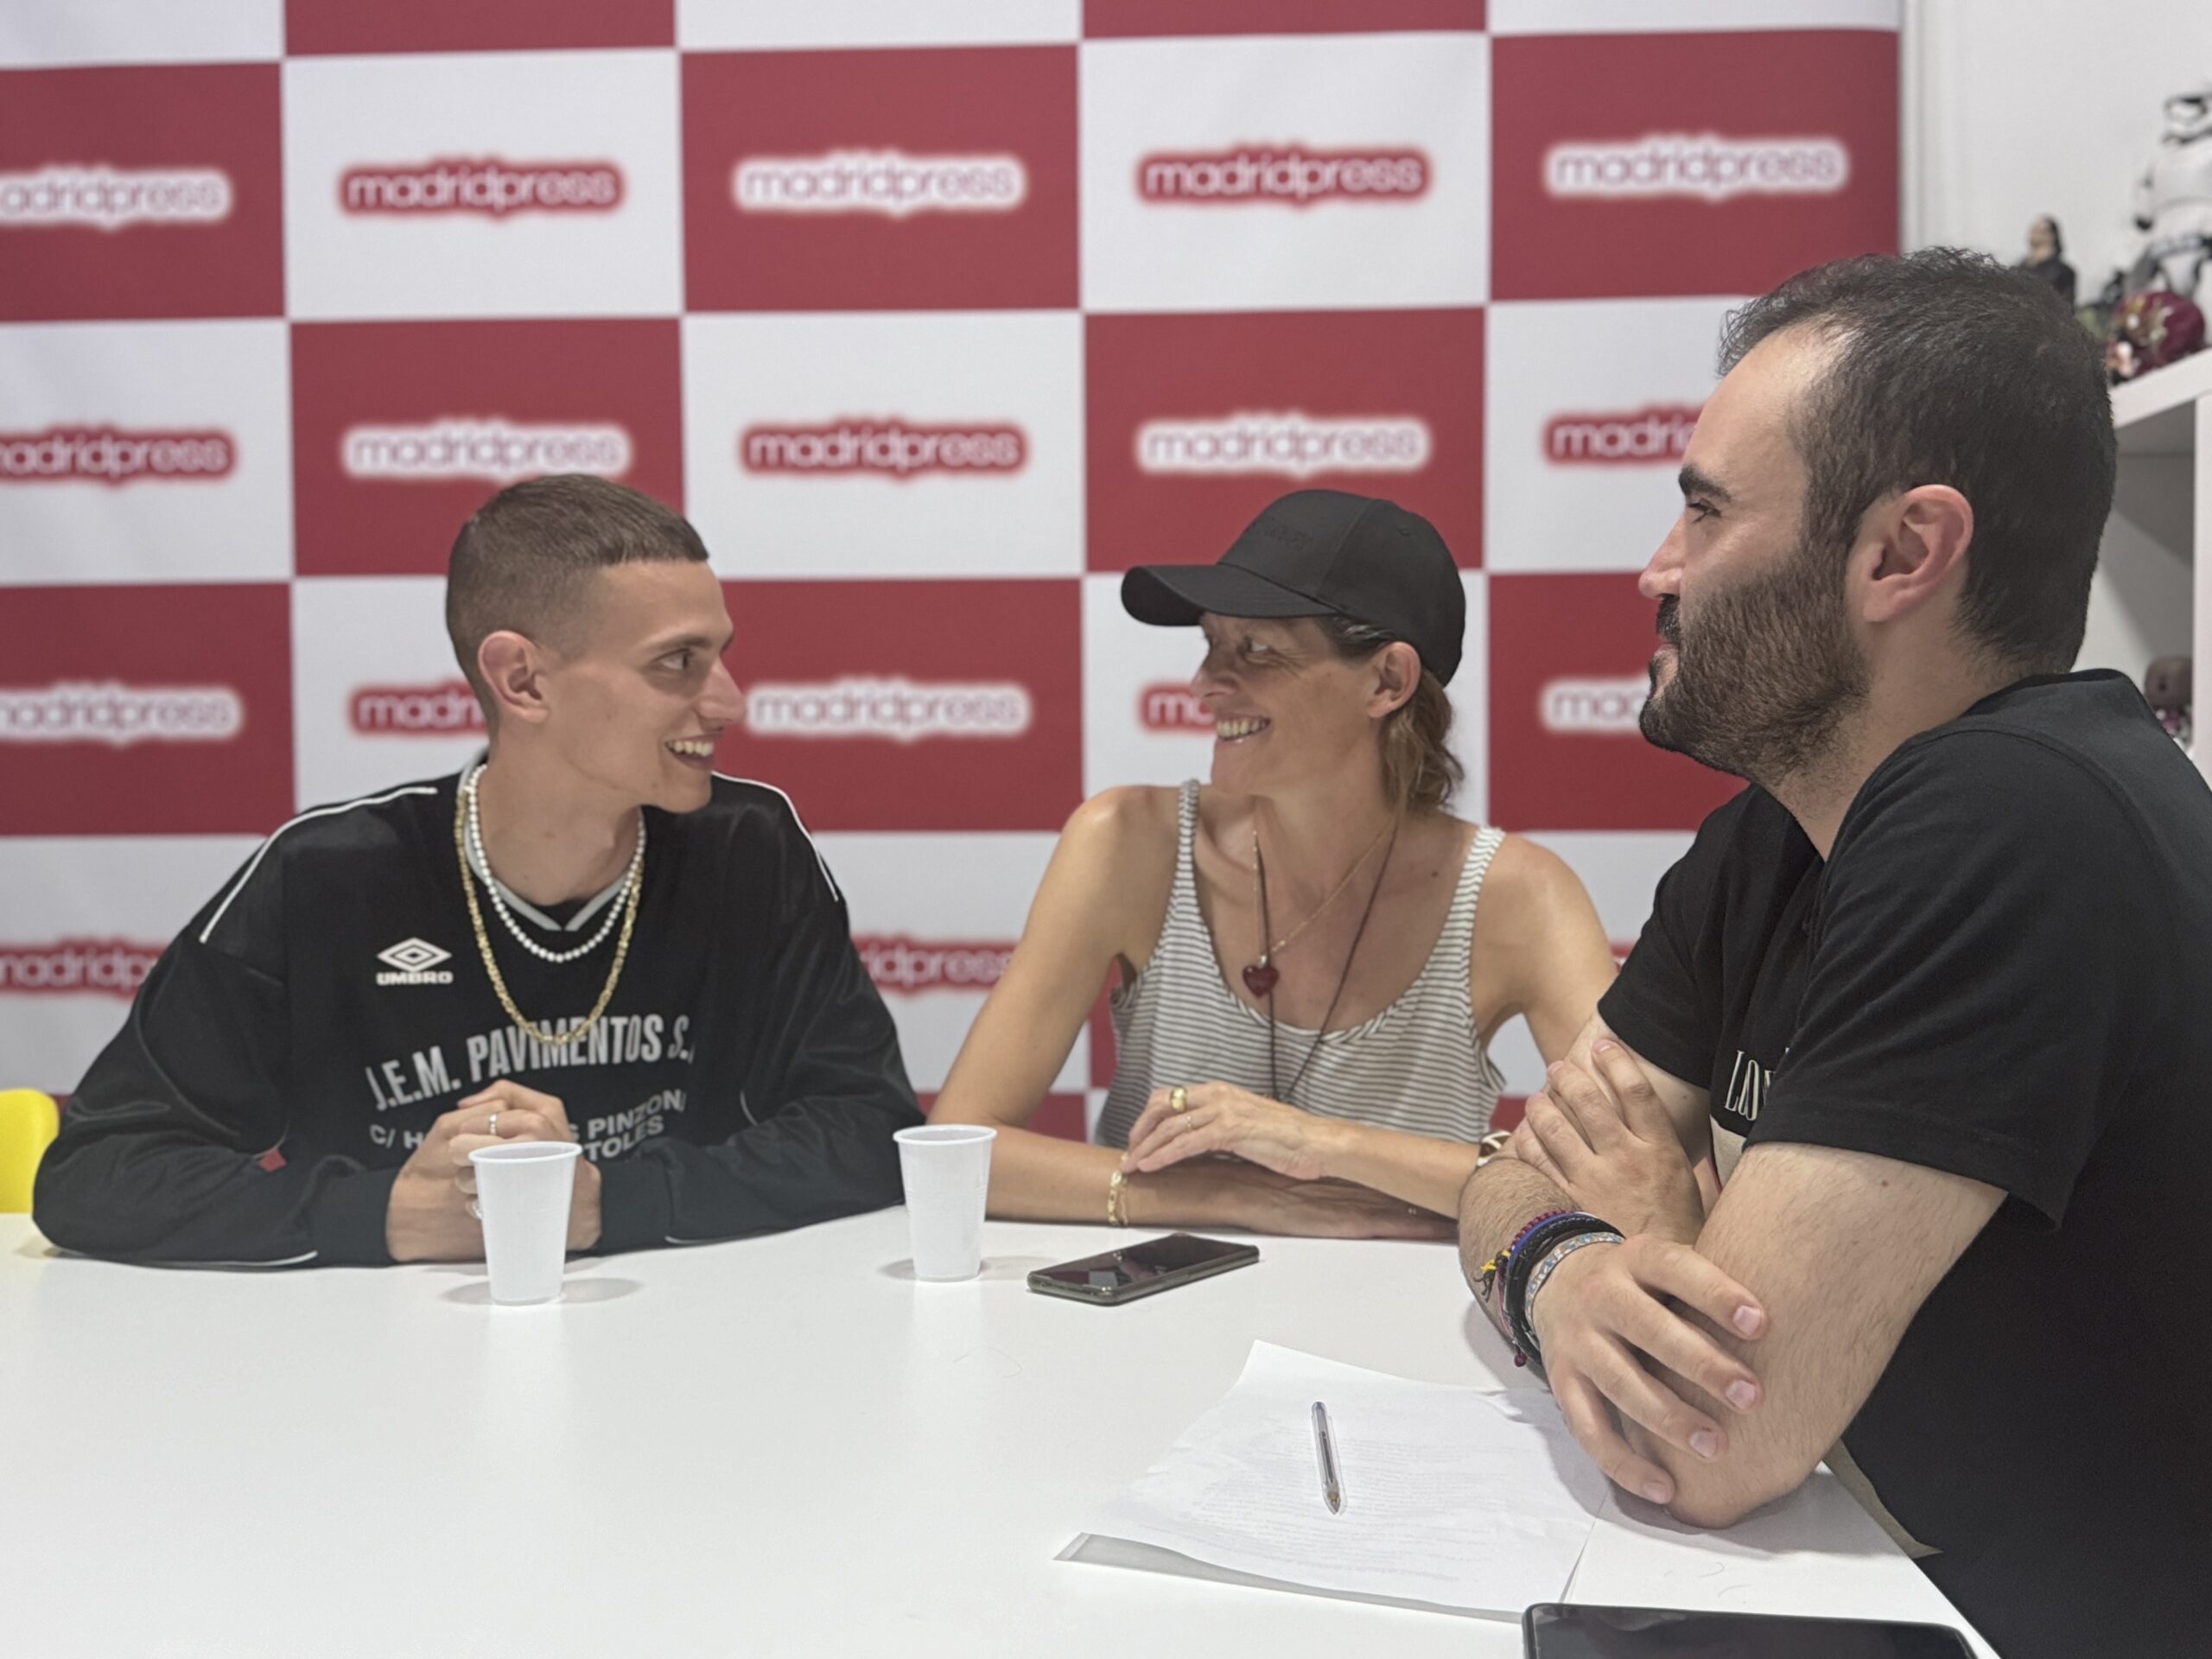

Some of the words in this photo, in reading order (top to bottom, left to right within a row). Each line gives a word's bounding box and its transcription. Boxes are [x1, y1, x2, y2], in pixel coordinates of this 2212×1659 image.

[347, 163, 618, 213] madridpress
[743, 156, 1016, 207] madridpress
[1145, 149, 1424, 201] madridpress
[1554, 139, 1839, 191] madridpress
[0, 169, 226, 220] adridpress
[0, 431, 229, 479] adridpress
[353, 423, 620, 473] madridpress
[748, 423, 1020, 474] madridpress
[1146, 419, 1421, 469] madridpress
[0, 685, 235, 734] adridpress
[753, 684, 1026, 734] madridpress
[376, 971, 454, 986] UMBRO
[365, 1046, 462, 1111] J.E.M.
[466, 1014, 664, 1084] PAVIMENTOS
[583, 1115, 664, 1161] TOLES
